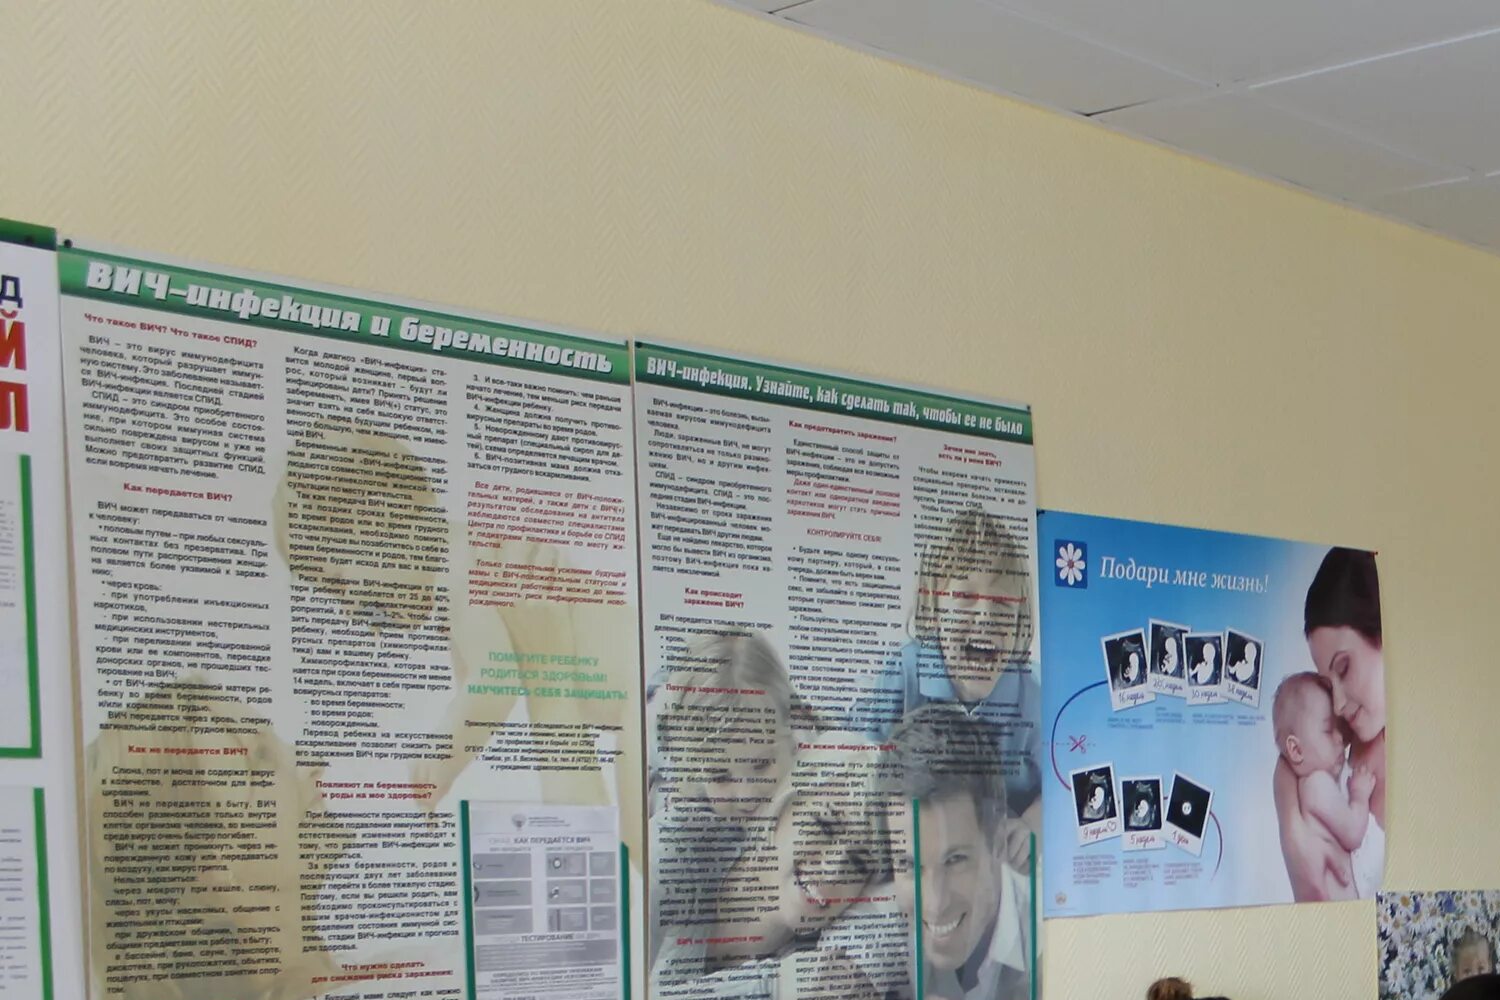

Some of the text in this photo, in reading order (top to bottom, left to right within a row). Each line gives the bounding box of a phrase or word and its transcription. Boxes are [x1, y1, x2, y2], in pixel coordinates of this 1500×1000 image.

[87, 261, 612, 374] ВИЧ-инфекция и беременность
[647, 357, 1023, 436] ВИЧ-инфекция. Узнайте, как сделать так, чтобы ее не было
[123, 482, 141, 492] Как
[206, 491, 232, 501] ВИЧ?
[1100, 556, 1269, 593] Подари мне жизнь!
[127, 745, 146, 753] Как
